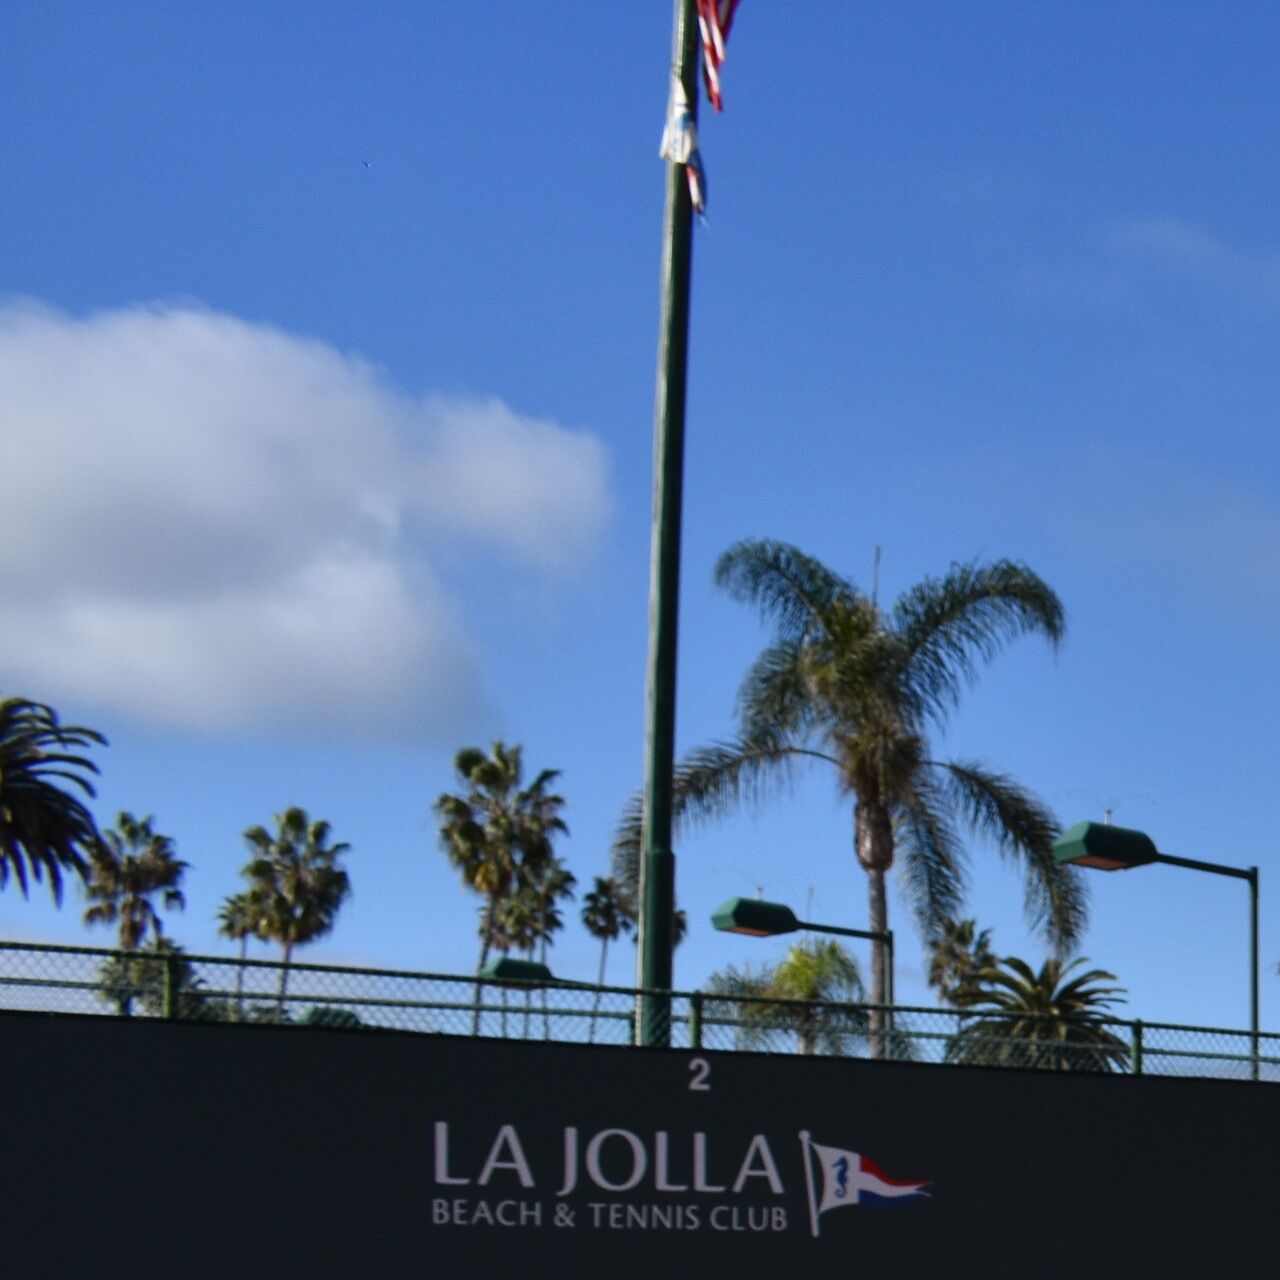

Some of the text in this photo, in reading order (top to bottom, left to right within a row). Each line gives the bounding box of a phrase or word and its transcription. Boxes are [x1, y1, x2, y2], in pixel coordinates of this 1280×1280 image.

[688, 1058, 711, 1091] 2
[434, 1121, 785, 1196] LA JOLLA
[432, 1198, 788, 1232] BEACH & TENNIS CLUB
